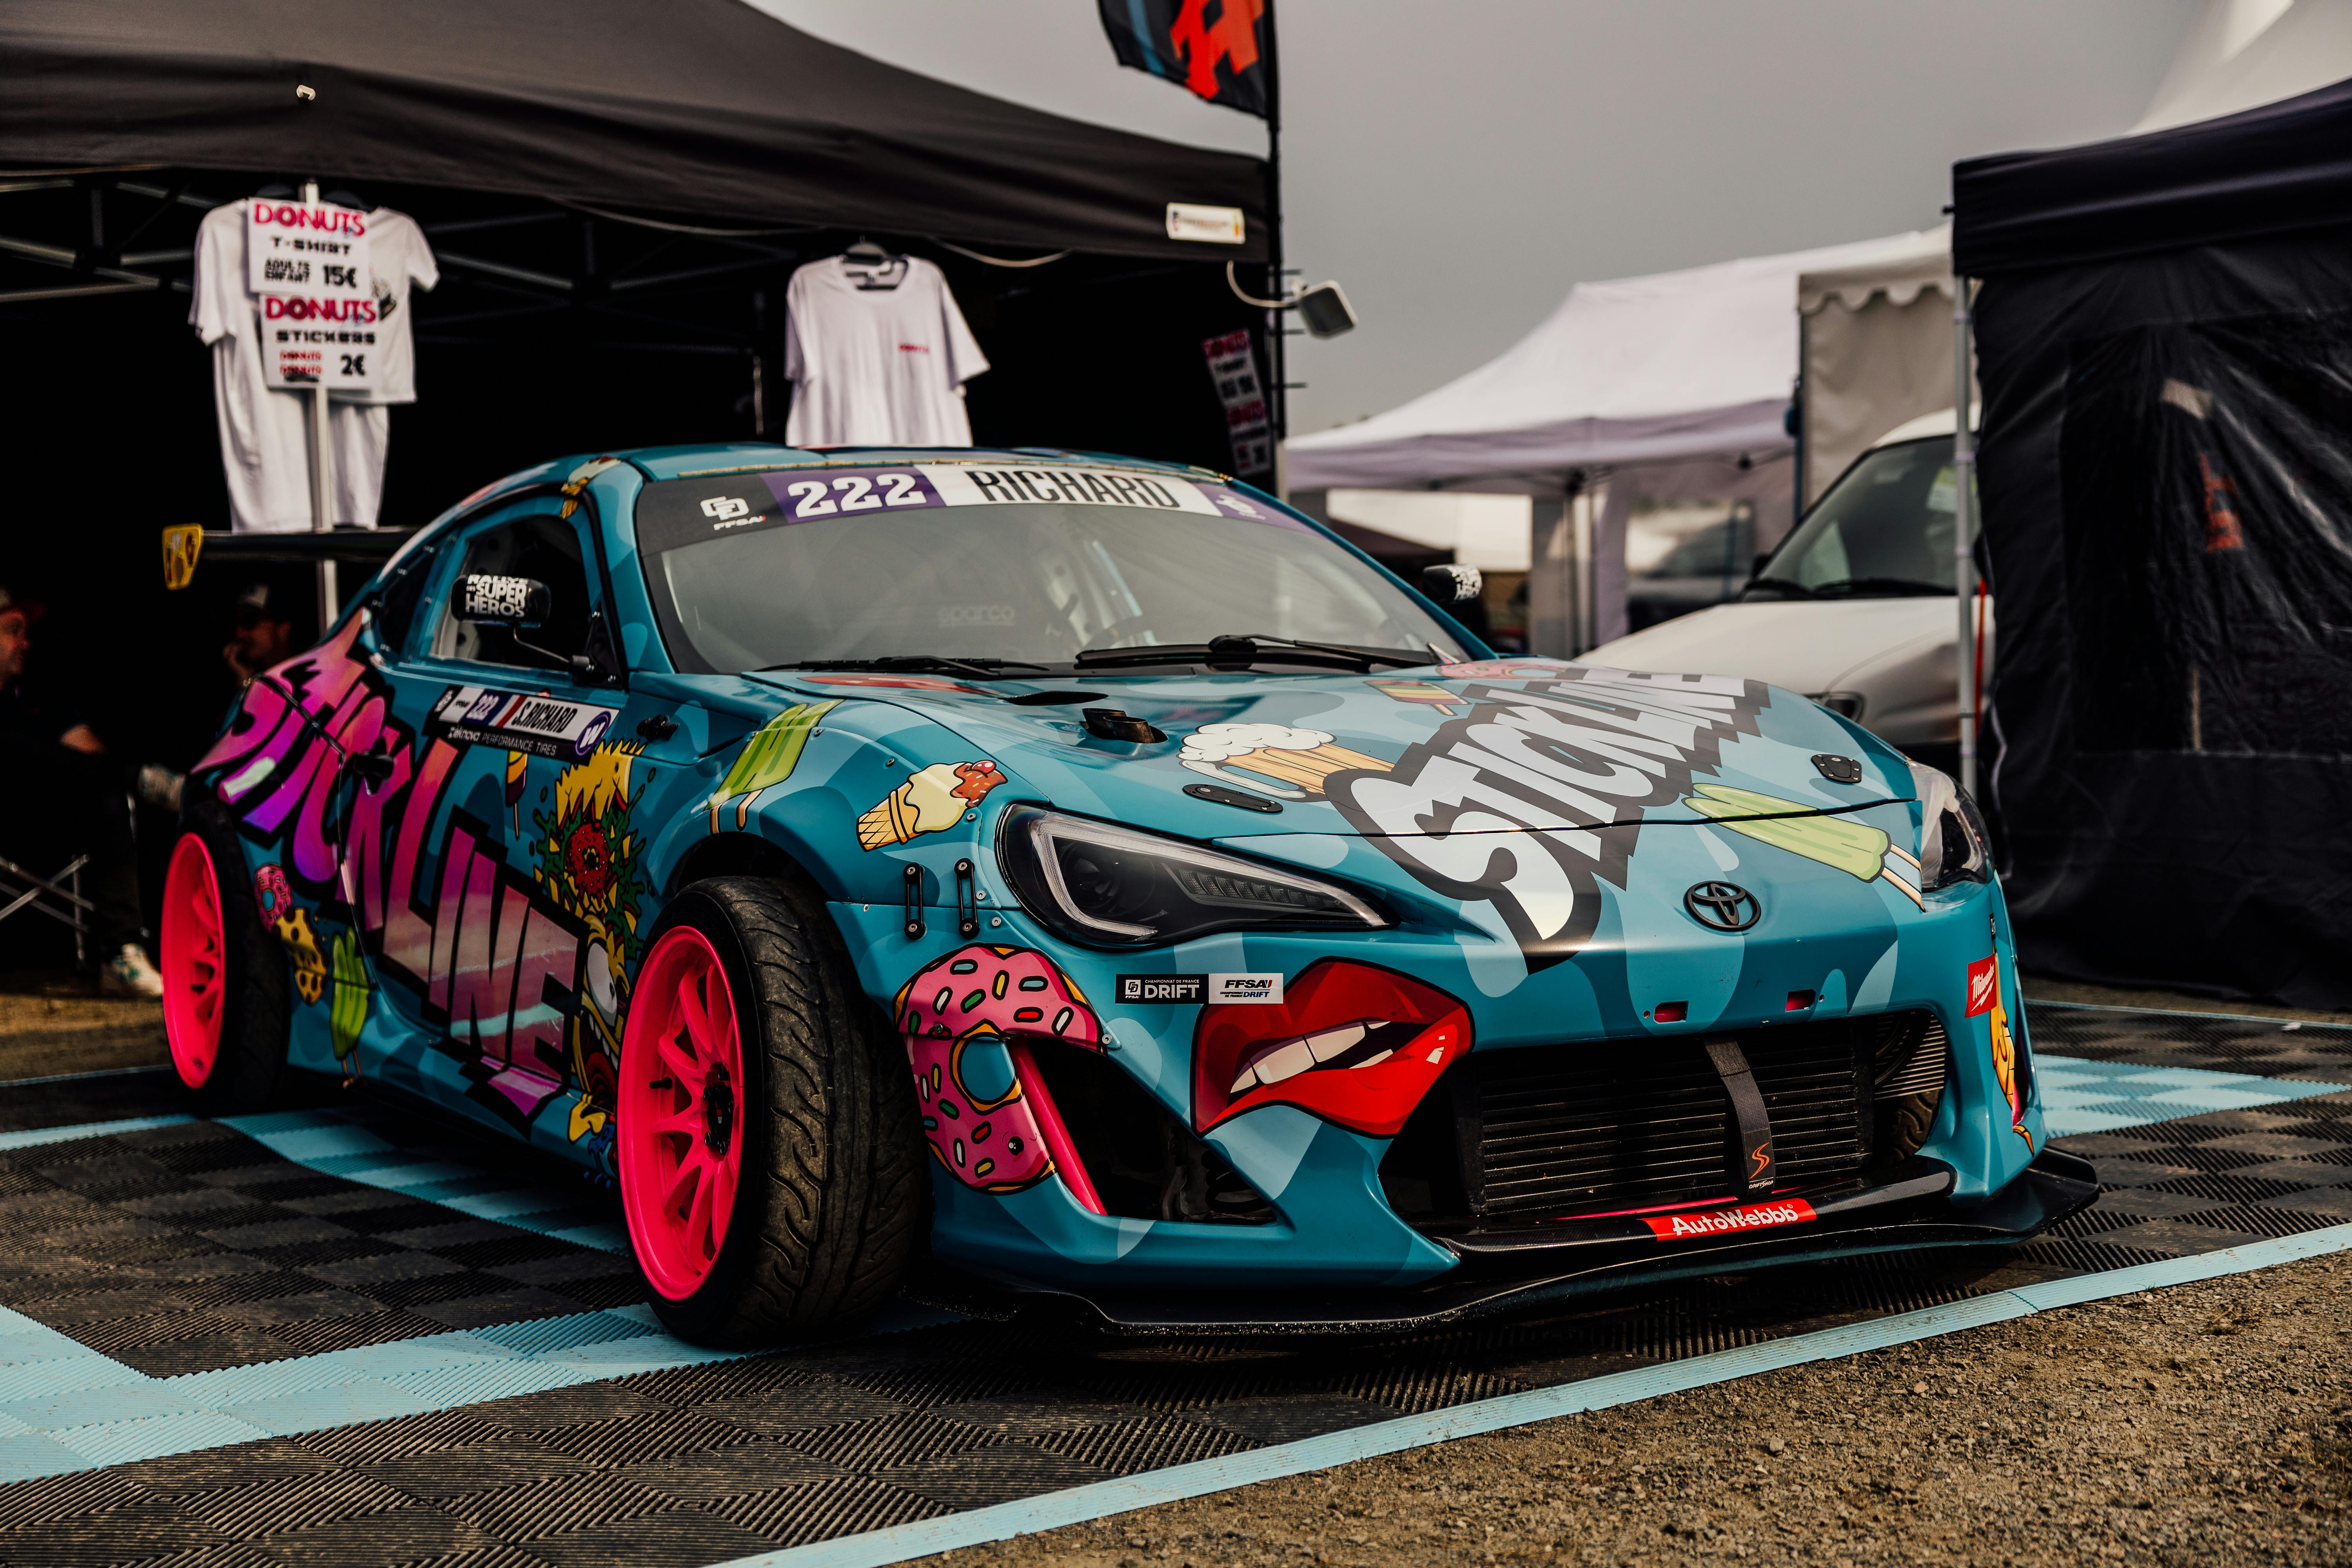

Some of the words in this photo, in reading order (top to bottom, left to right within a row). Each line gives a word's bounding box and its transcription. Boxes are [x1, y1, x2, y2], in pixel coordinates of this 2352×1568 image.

[254, 201, 365, 236] DONUTS
[270, 236, 351, 256] T-SHIRT
[323, 265, 357, 289] 15€
[265, 297, 376, 324] DONUTS
[276, 330, 376, 345] STICKERS
[340, 353, 365, 376] 2€
[787, 473, 927, 518] 222
[964, 470, 1181, 508] RICHARD
[465, 592, 525, 618] HEROS
[476, 583, 527, 608] SUPER
[466, 693, 500, 721] 222
[511, 701, 578, 733] S.RICHARD
[482, 732, 534, 752] PERFORMANCE
[535, 742, 557, 756] TIRES
[1145, 984, 1200, 998] DRIFT
[1224, 980, 1272, 988] FFSA
[1671, 1206, 1799, 1236] AutoWebbb
